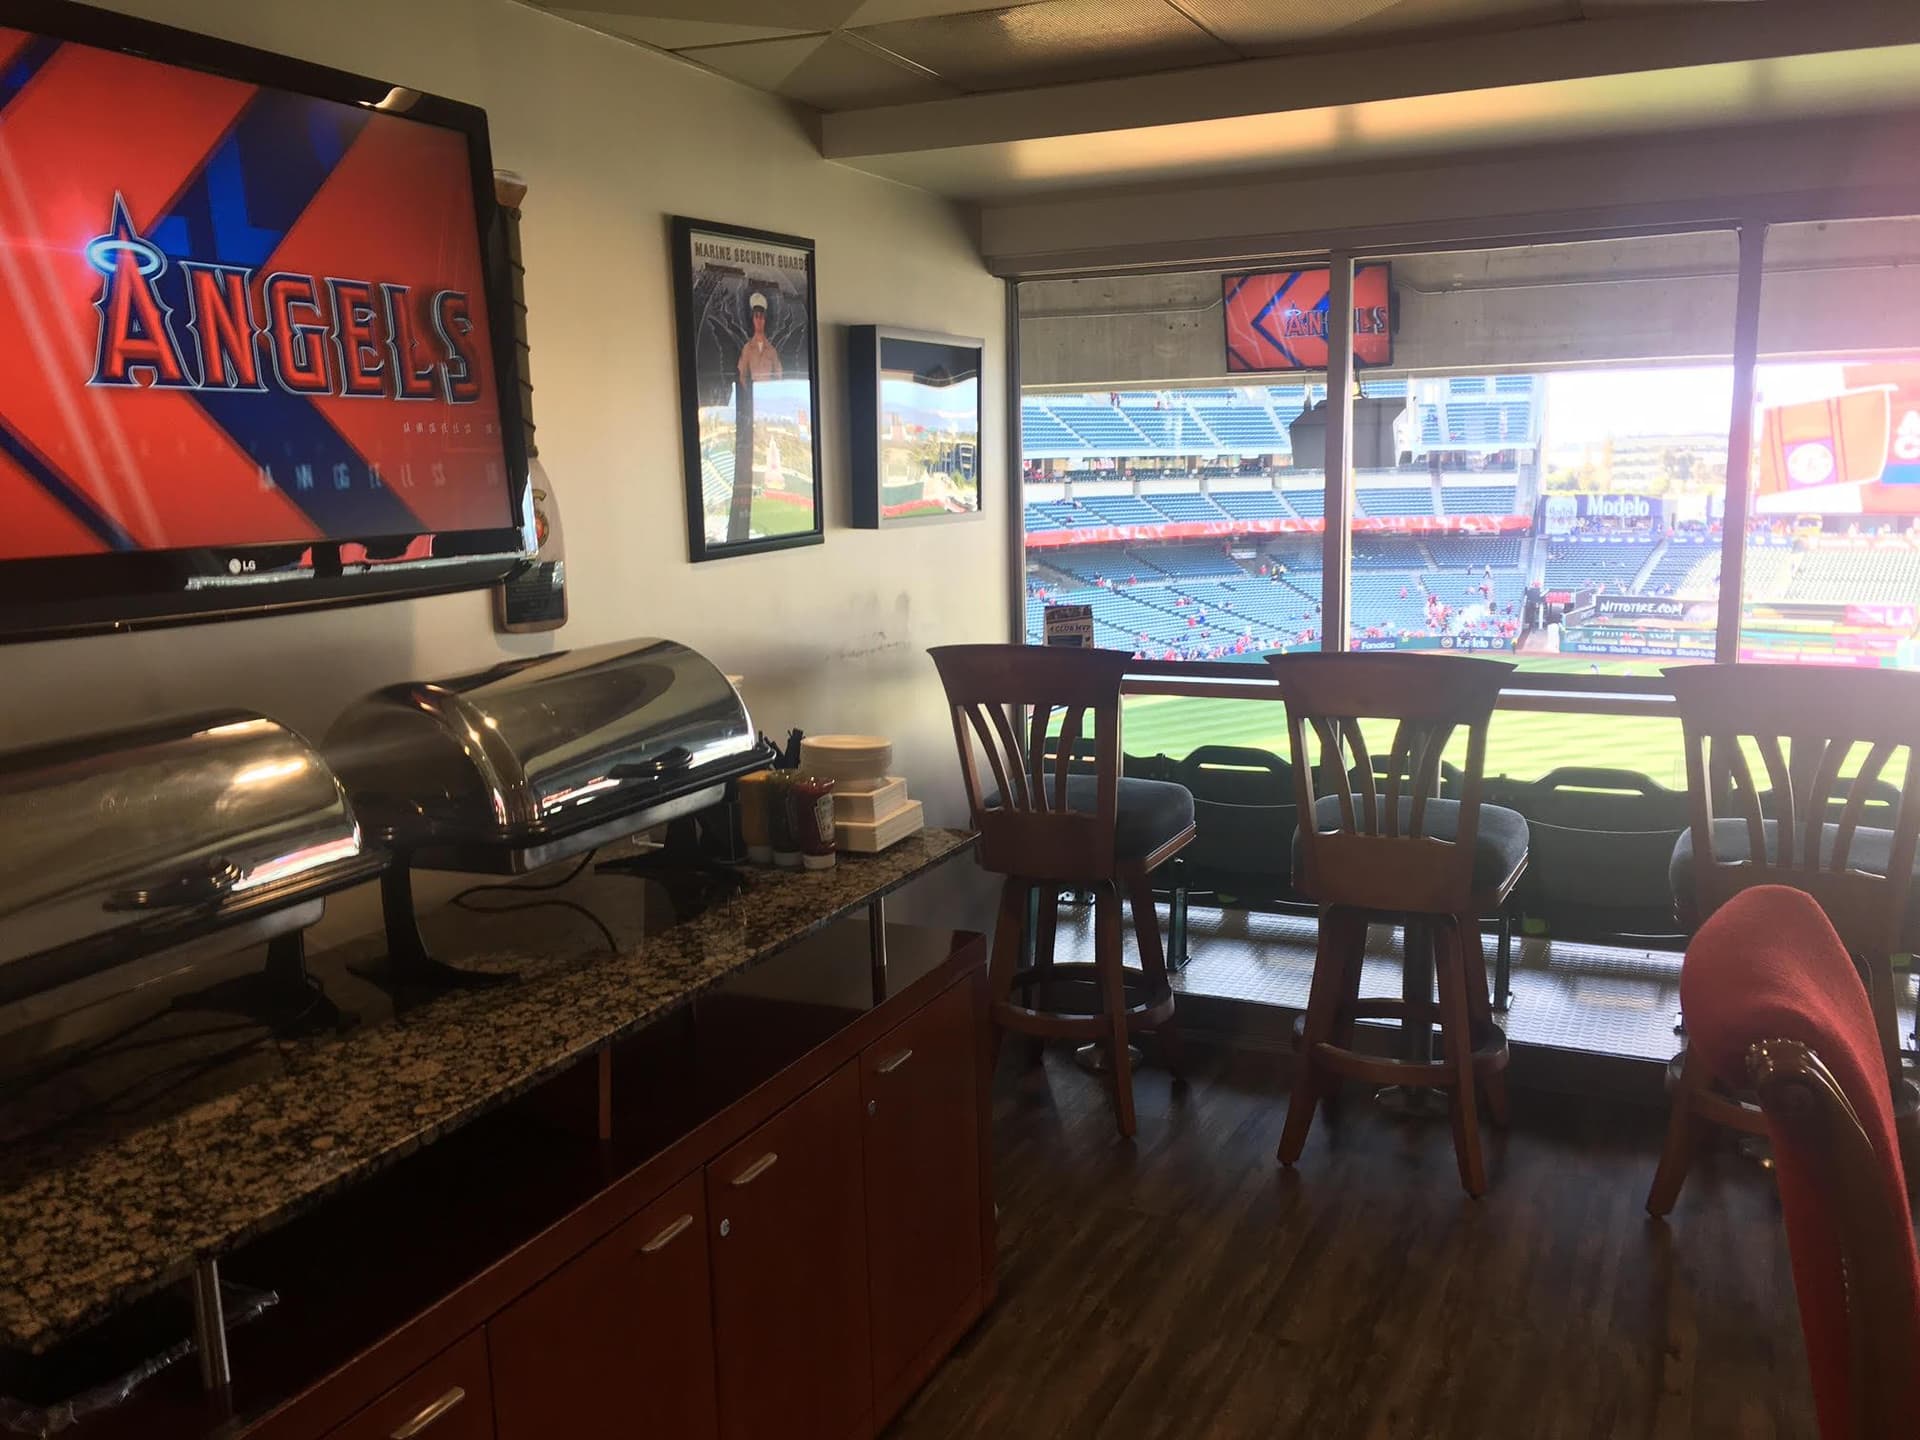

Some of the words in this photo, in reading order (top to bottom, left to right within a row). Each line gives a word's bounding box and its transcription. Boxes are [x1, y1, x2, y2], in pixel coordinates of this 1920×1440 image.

[695, 241, 731, 261] MARINE
[734, 248, 775, 267] SECURITY
[84, 190, 484, 405] ANGELS
[1283, 300, 1387, 338] ANLS
[1586, 494, 1651, 517] Modelo
[242, 559, 256, 571] LG
[1361, 641, 1396, 650] Fanatics
